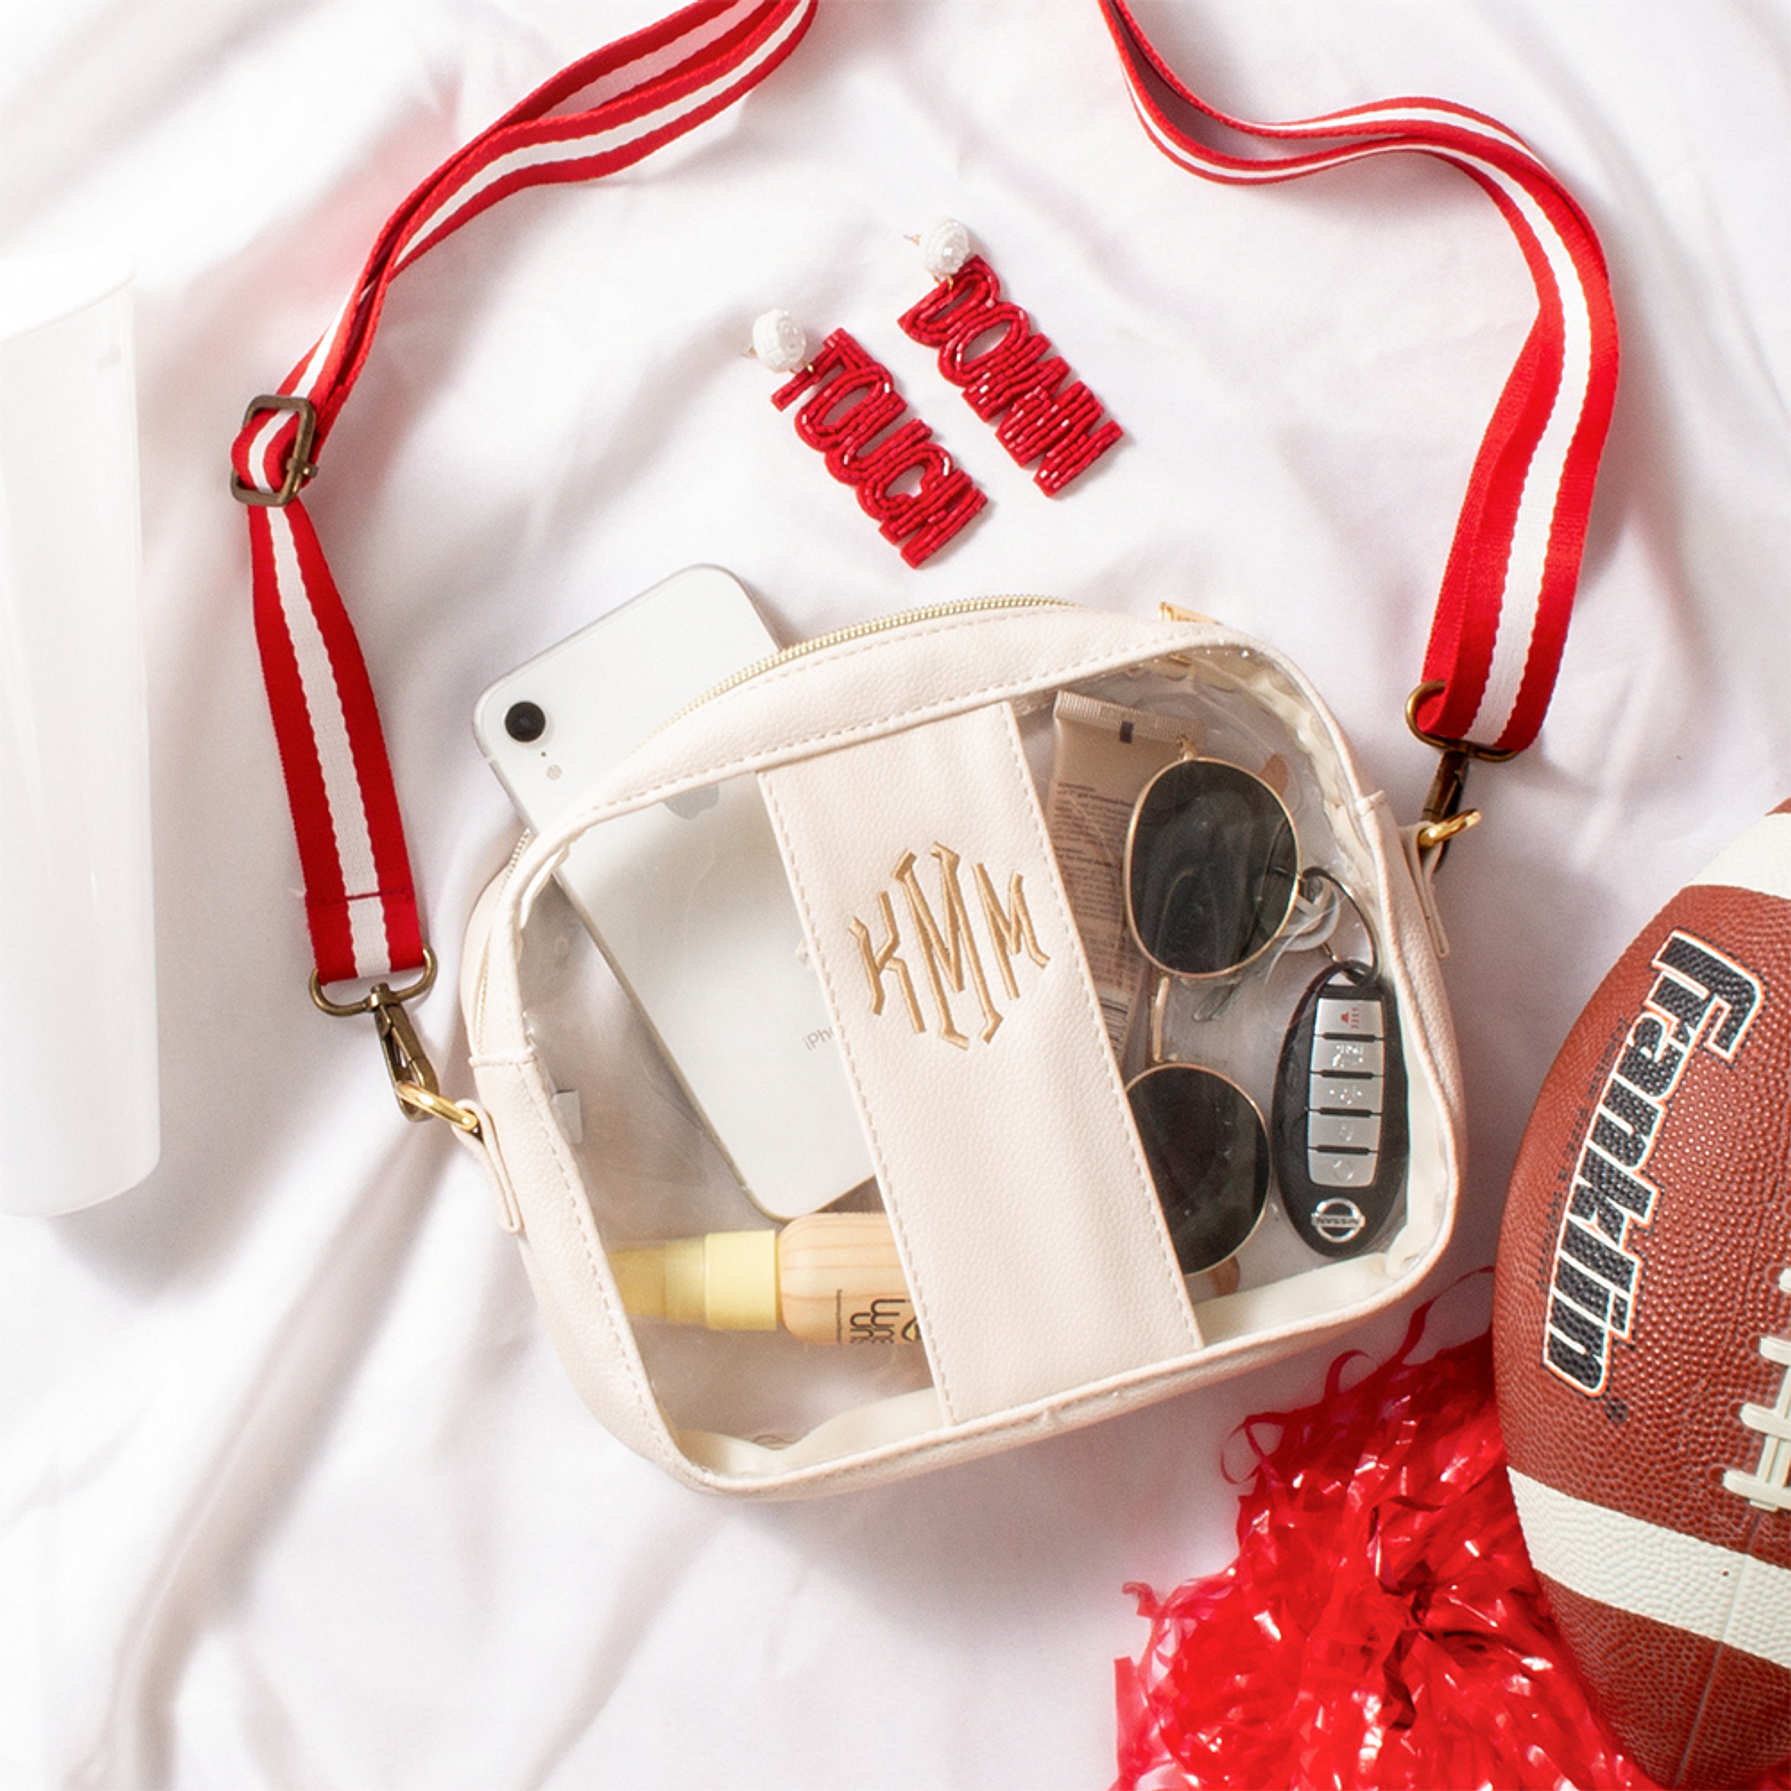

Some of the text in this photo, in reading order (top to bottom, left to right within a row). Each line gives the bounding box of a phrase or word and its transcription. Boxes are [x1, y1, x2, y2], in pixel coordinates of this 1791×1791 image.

[770, 327, 988, 570] TOUCH
[897, 255, 1123, 498] DOWN
[1542, 927, 1767, 1399] Franklin
